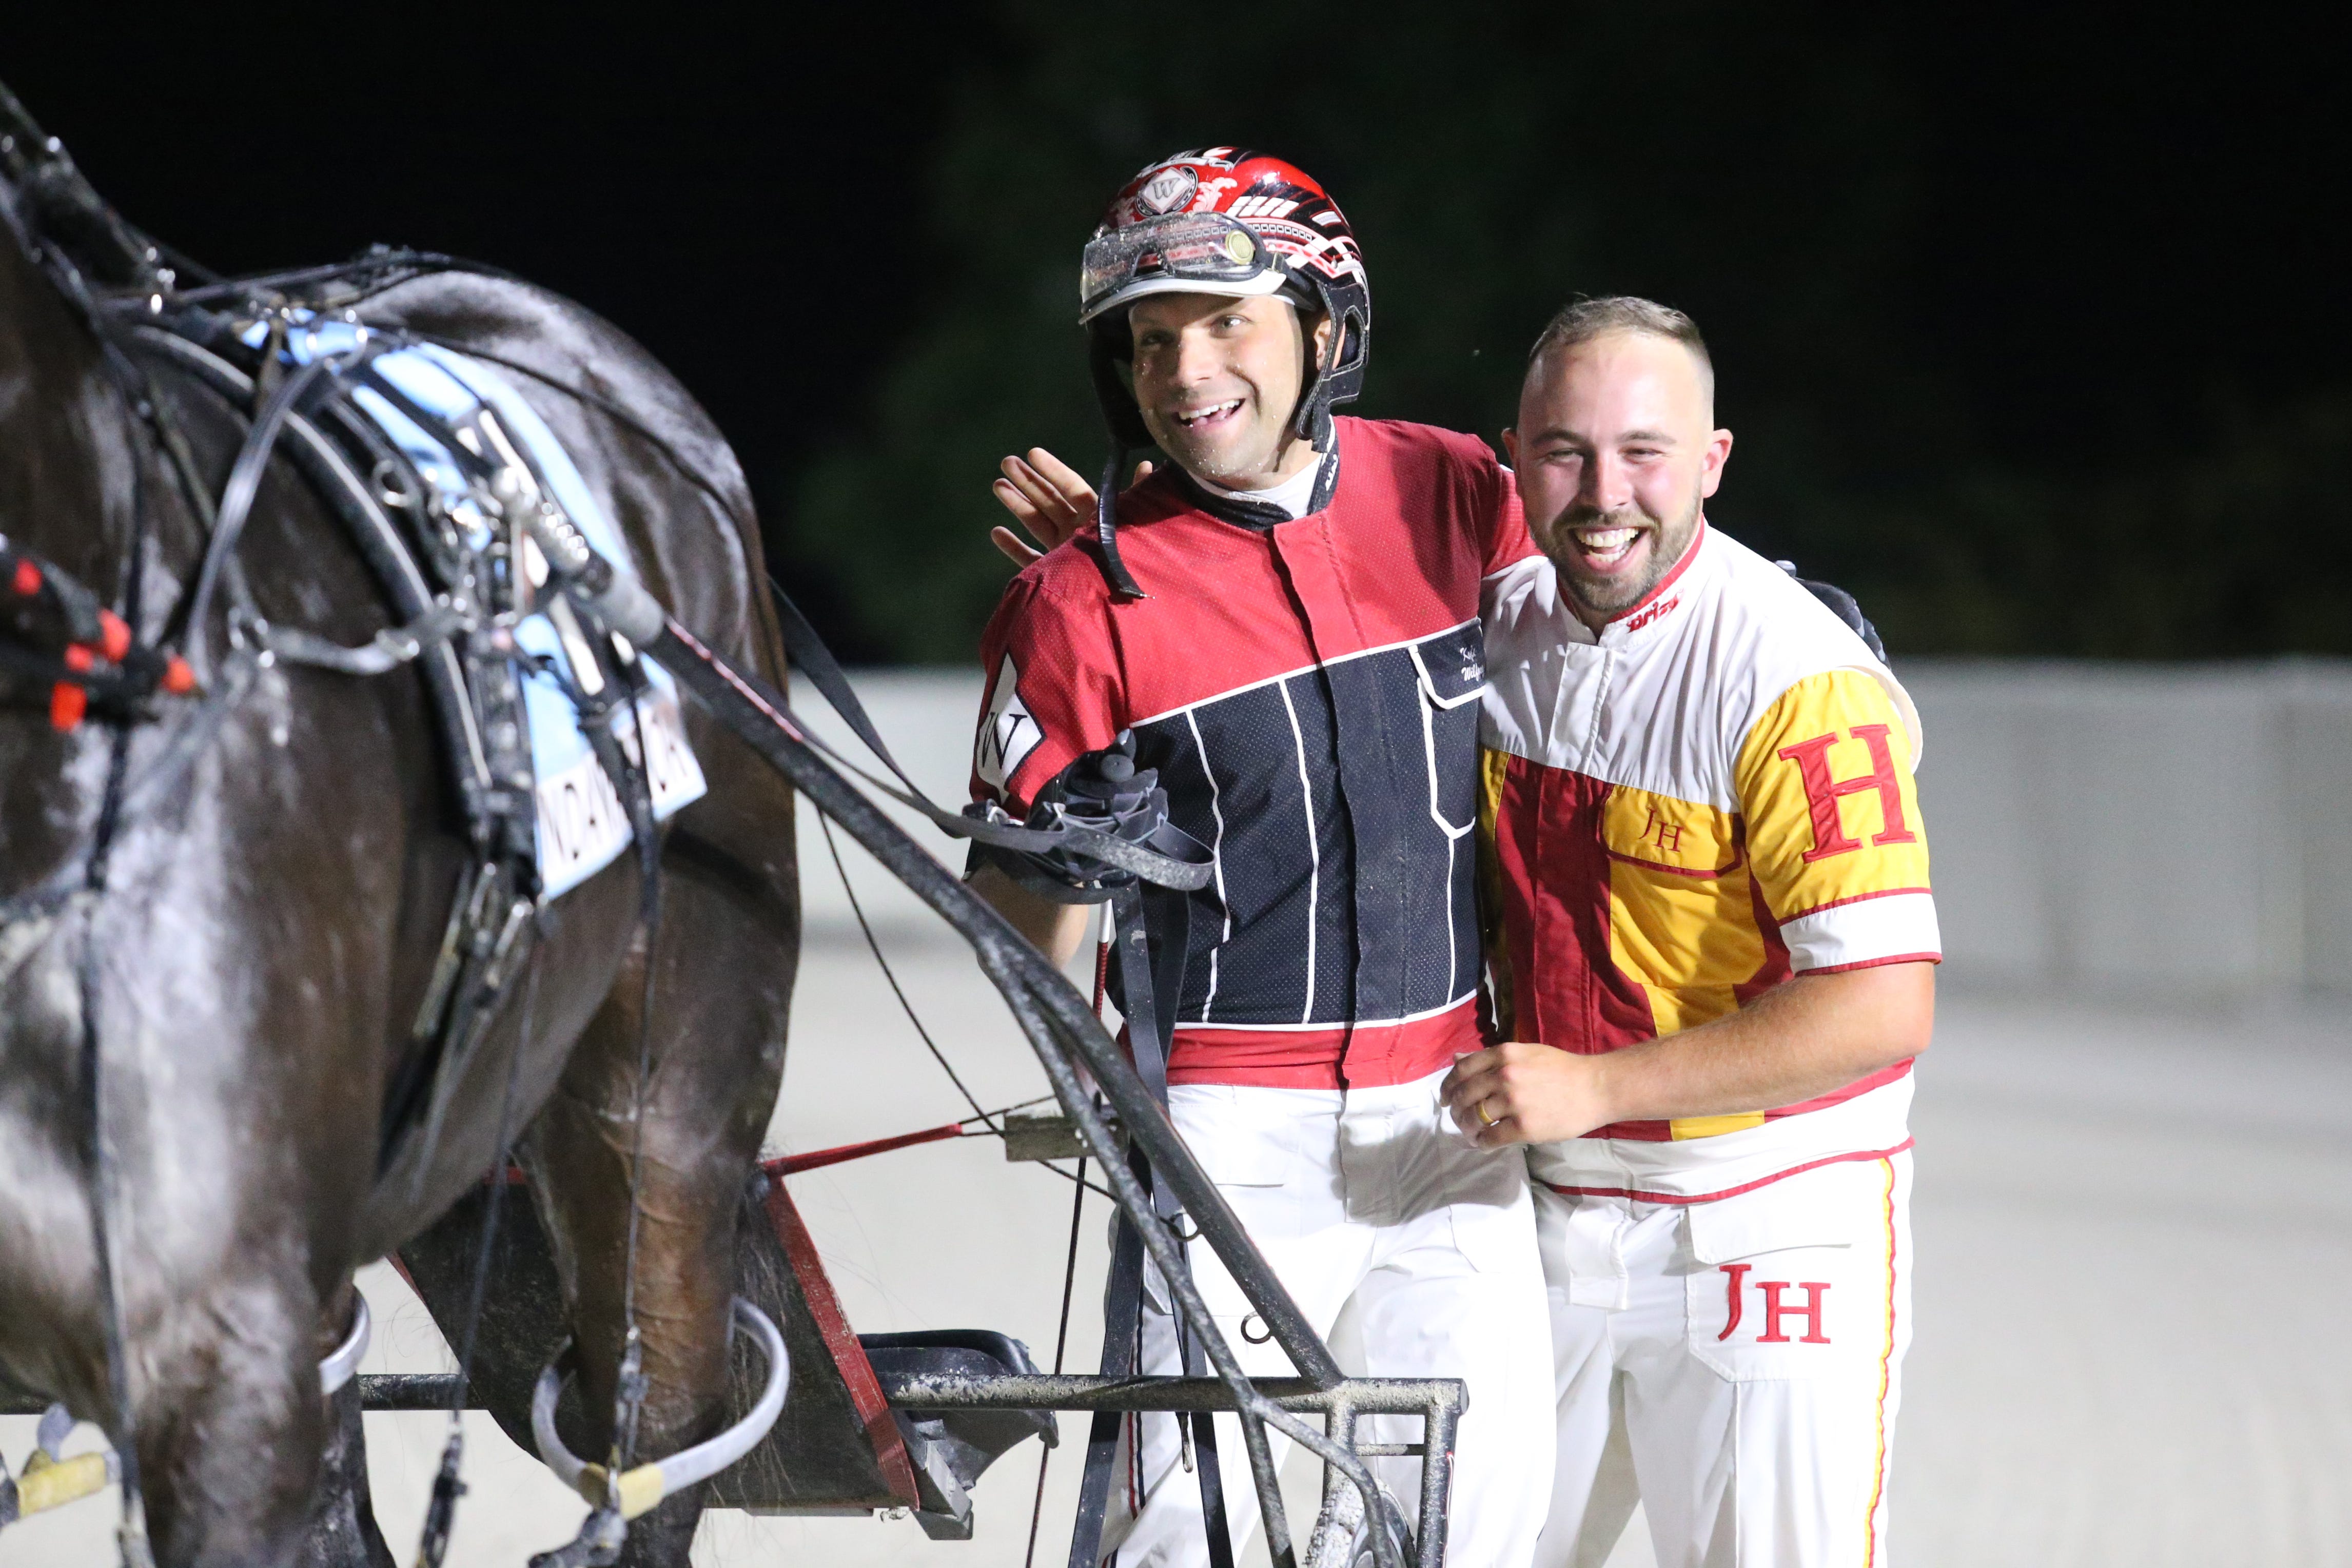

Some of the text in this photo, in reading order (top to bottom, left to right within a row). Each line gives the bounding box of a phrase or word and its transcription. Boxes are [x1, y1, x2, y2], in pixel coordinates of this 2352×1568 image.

[1152, 177, 1181, 200] W
[982, 712, 1028, 770] W
[1777, 723, 1917, 864] H
[1638, 807, 1684, 852] JH
[1718, 1264, 1831, 1344] JH
